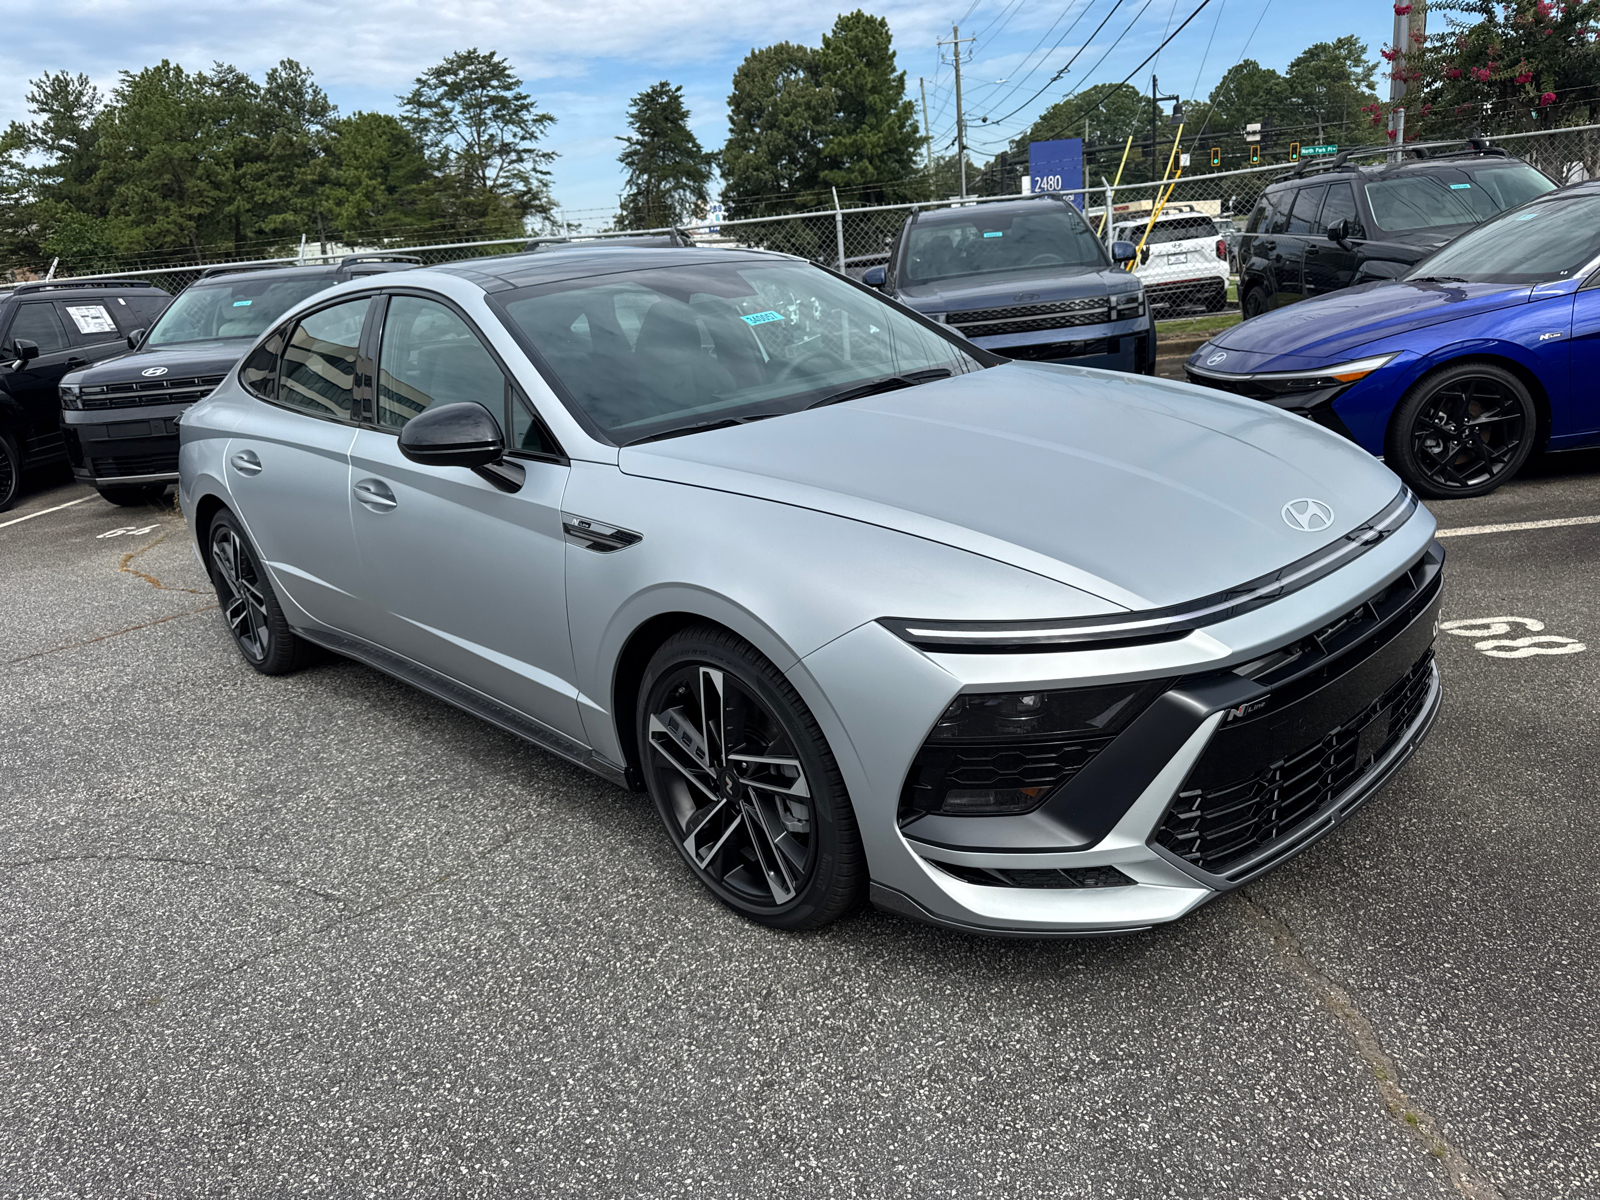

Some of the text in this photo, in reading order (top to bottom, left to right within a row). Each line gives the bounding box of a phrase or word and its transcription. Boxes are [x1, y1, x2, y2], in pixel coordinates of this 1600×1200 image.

[1034, 175, 1062, 193] 2480
[1439, 616, 1587, 659] 68
[1227, 704, 1247, 721] N
